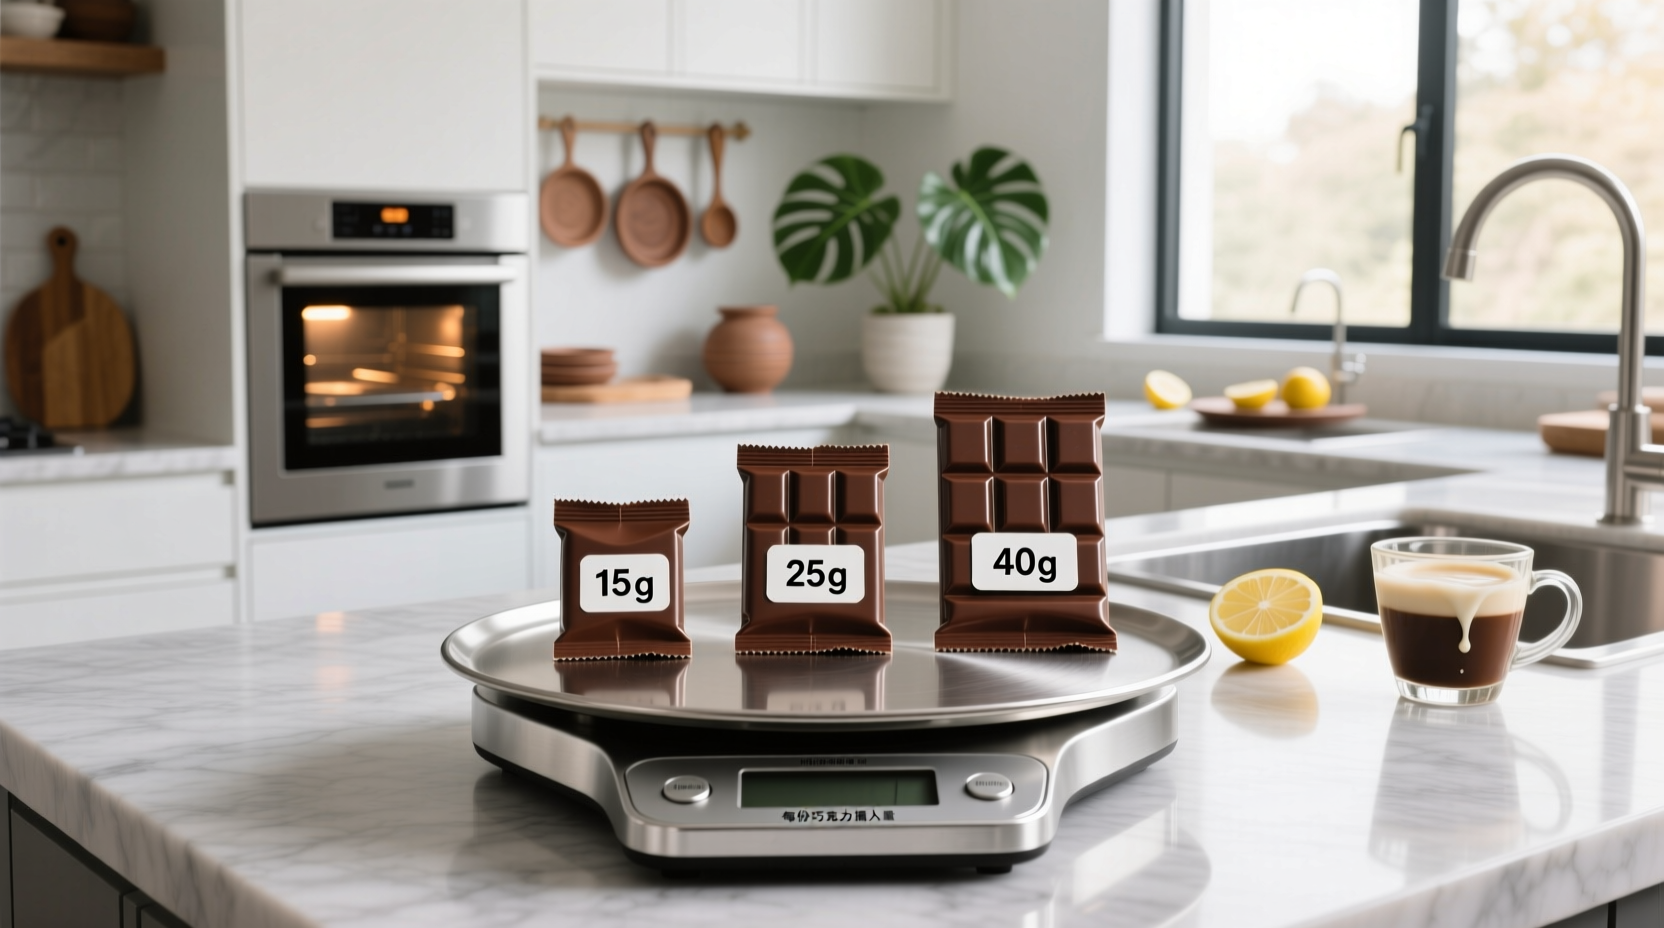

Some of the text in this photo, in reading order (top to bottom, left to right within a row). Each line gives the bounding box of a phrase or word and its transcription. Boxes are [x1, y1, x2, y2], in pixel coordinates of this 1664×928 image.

[786, 559, 847, 595] 25g
[992, 547, 1057, 584] 40g
[595, 568, 654, 604] 15g
